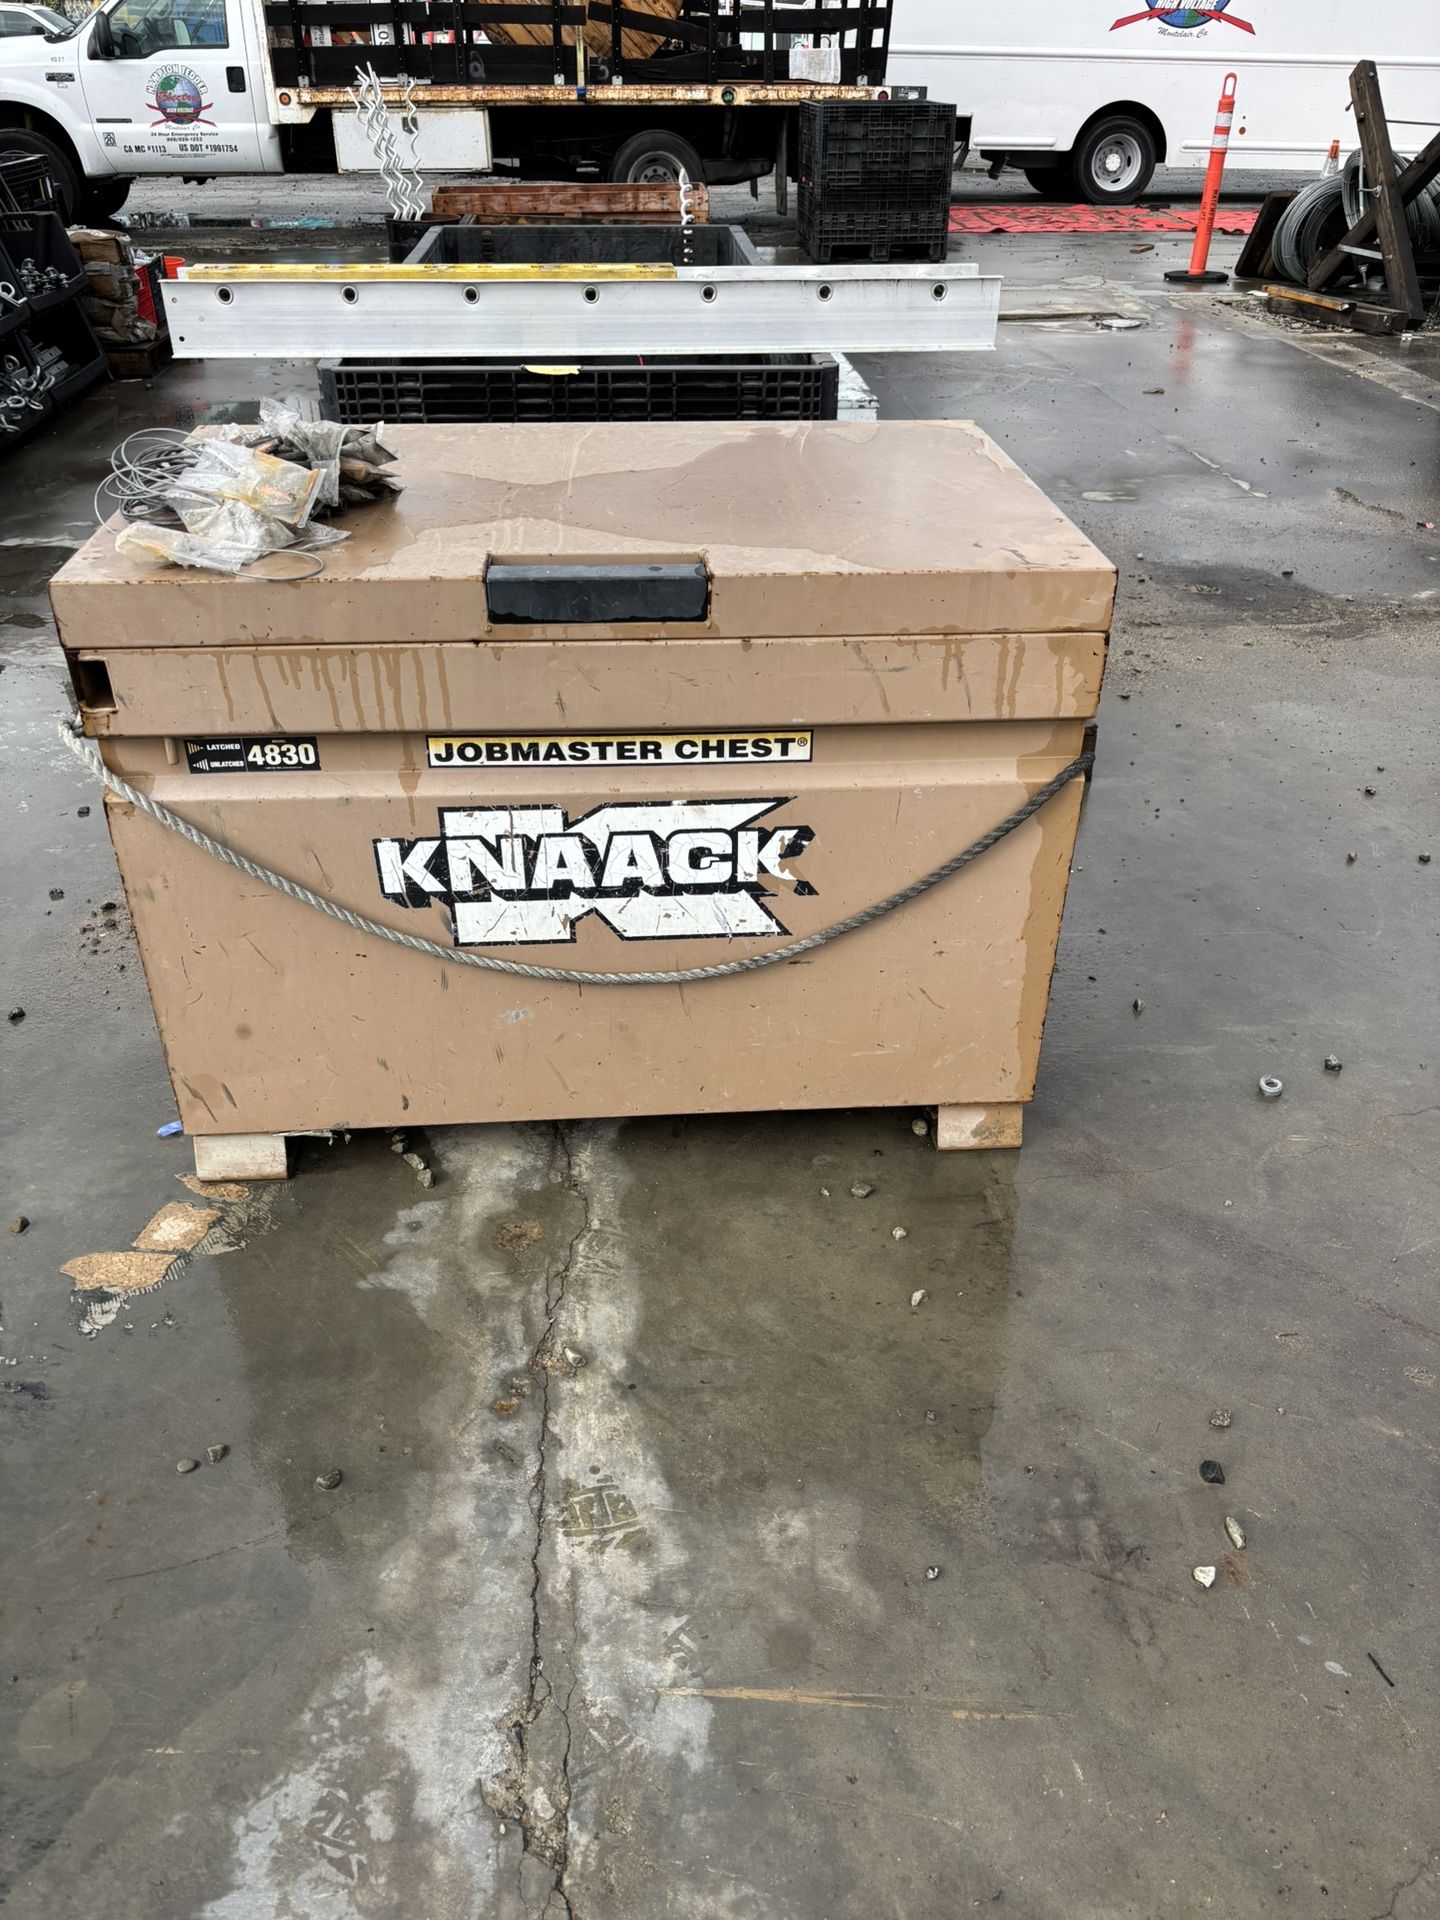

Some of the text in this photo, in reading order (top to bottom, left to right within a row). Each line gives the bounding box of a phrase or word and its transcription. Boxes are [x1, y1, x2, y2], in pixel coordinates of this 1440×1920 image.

[146, 64, 208, 96] HAMPTON TEDDER
[123, 145, 133, 153] CA
[134, 145, 146, 153] MC
[178, 143, 189, 152] US
[190, 143, 203, 152] DOT
[206, 743, 240, 751] LATCHED
[247, 743, 316, 766] 4830
[434, 740, 663, 764] JOBMASTER
[209, 760, 244, 769] UNLATCHED
[375, 827, 814, 900] KNAACK
